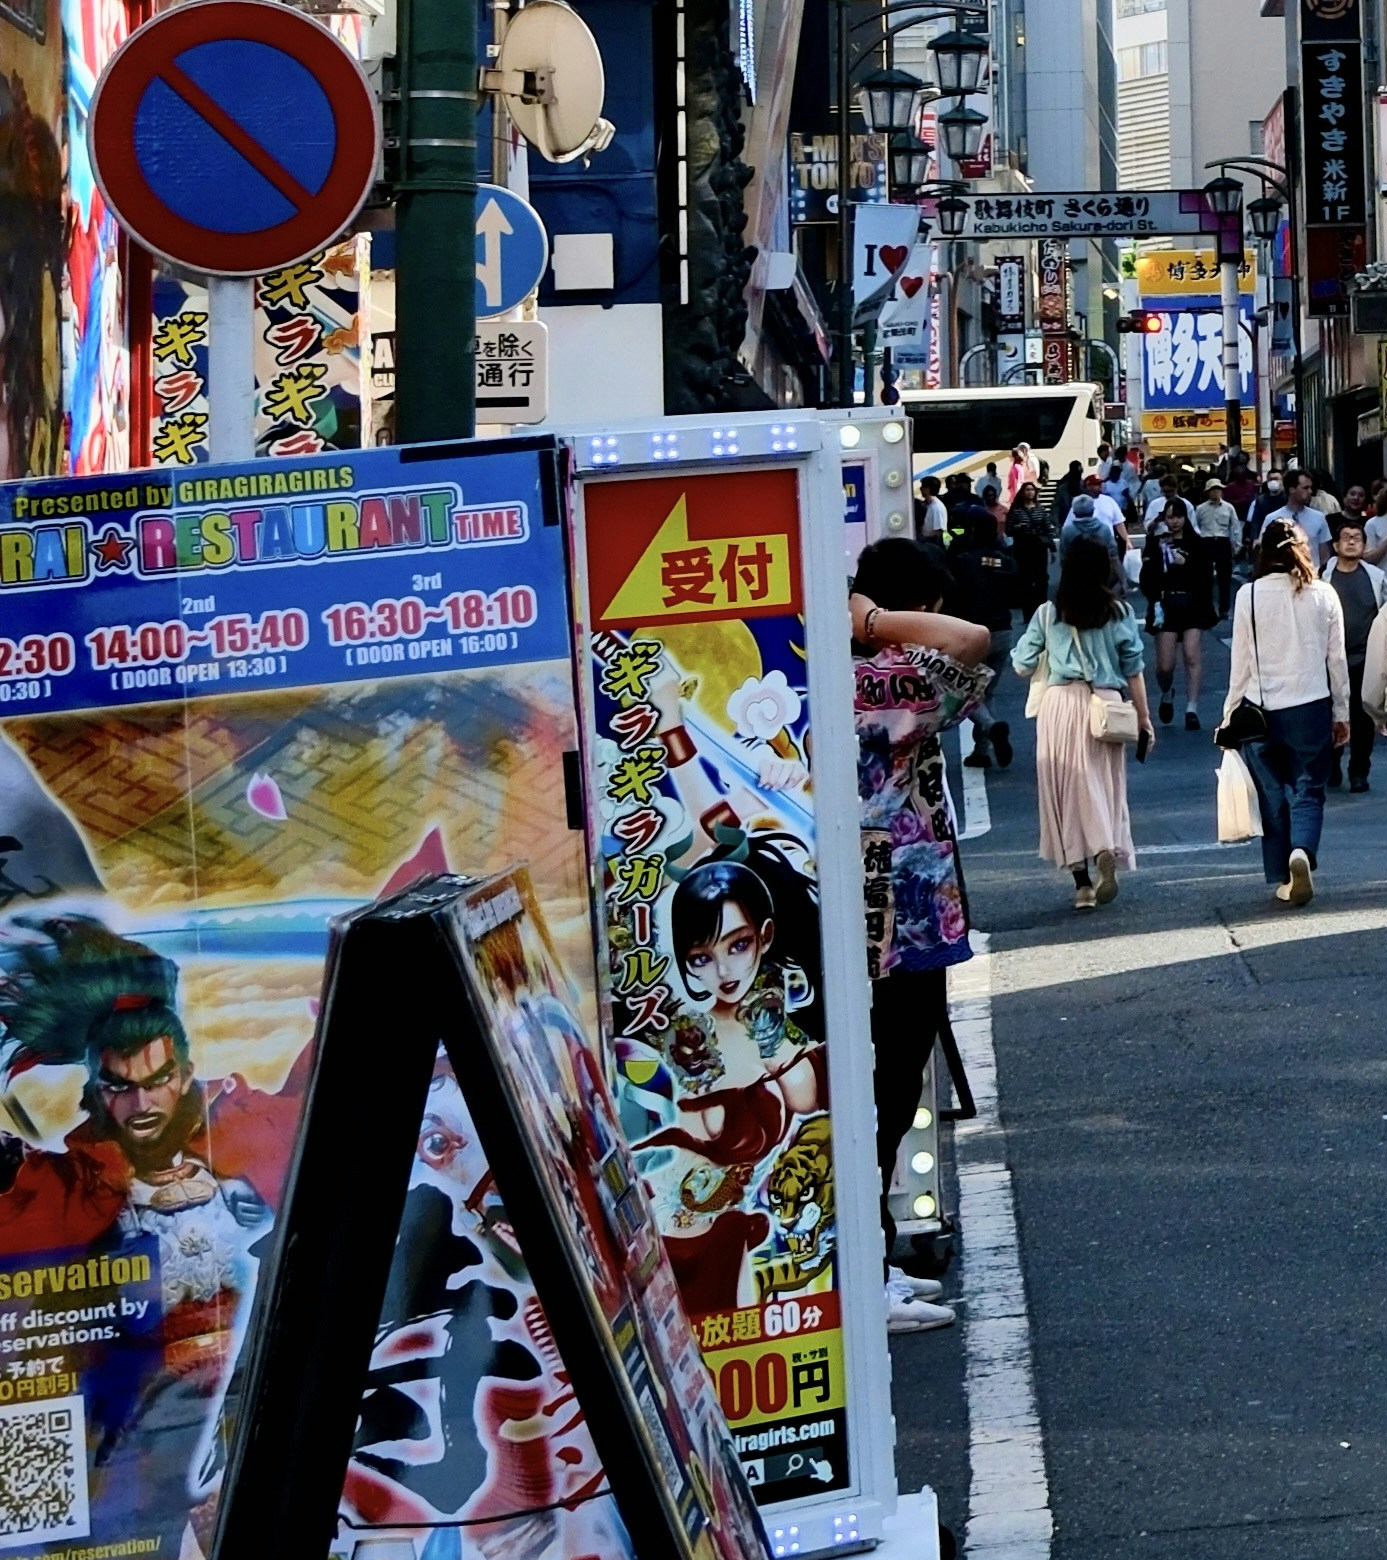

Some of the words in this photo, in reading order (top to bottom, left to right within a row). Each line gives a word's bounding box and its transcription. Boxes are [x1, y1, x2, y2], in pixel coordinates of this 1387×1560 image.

[974, 199, 1055, 220] 歌舞伎町
[1063, 196, 1150, 219] さくら通り
[1322, 206, 1350, 221] 1F
[973, 221, 1048, 234] Kabukicho
[1051, 219, 1134, 232] Sakura-dori
[1137, 219, 1158, 232] St.
[15, 489, 140, 519] Presented
[145, 484, 175, 510] by
[178, 466, 354, 504] GIRAGIRAGIRLS
[139, 490, 455, 571] RESTAURANT
[454, 510, 522, 542] TIME
[411, 571, 442, 592] 3rd
[661, 542, 777, 607] 受付
[181, 594, 215, 616] 2nd
[355, 643, 404, 665] DOOR
[407, 640, 453, 661] OPEN
[459, 633, 506, 655] 16:00
[122, 665, 173, 689] DOOR
[176, 663, 221, 686] OPEN
[227, 657, 275, 679] 13:30
[600, 639, 669, 1034] ギラギラガールズ
[22, 1300, 117, 1330] discount
[120, 1297, 150, 1320] by
